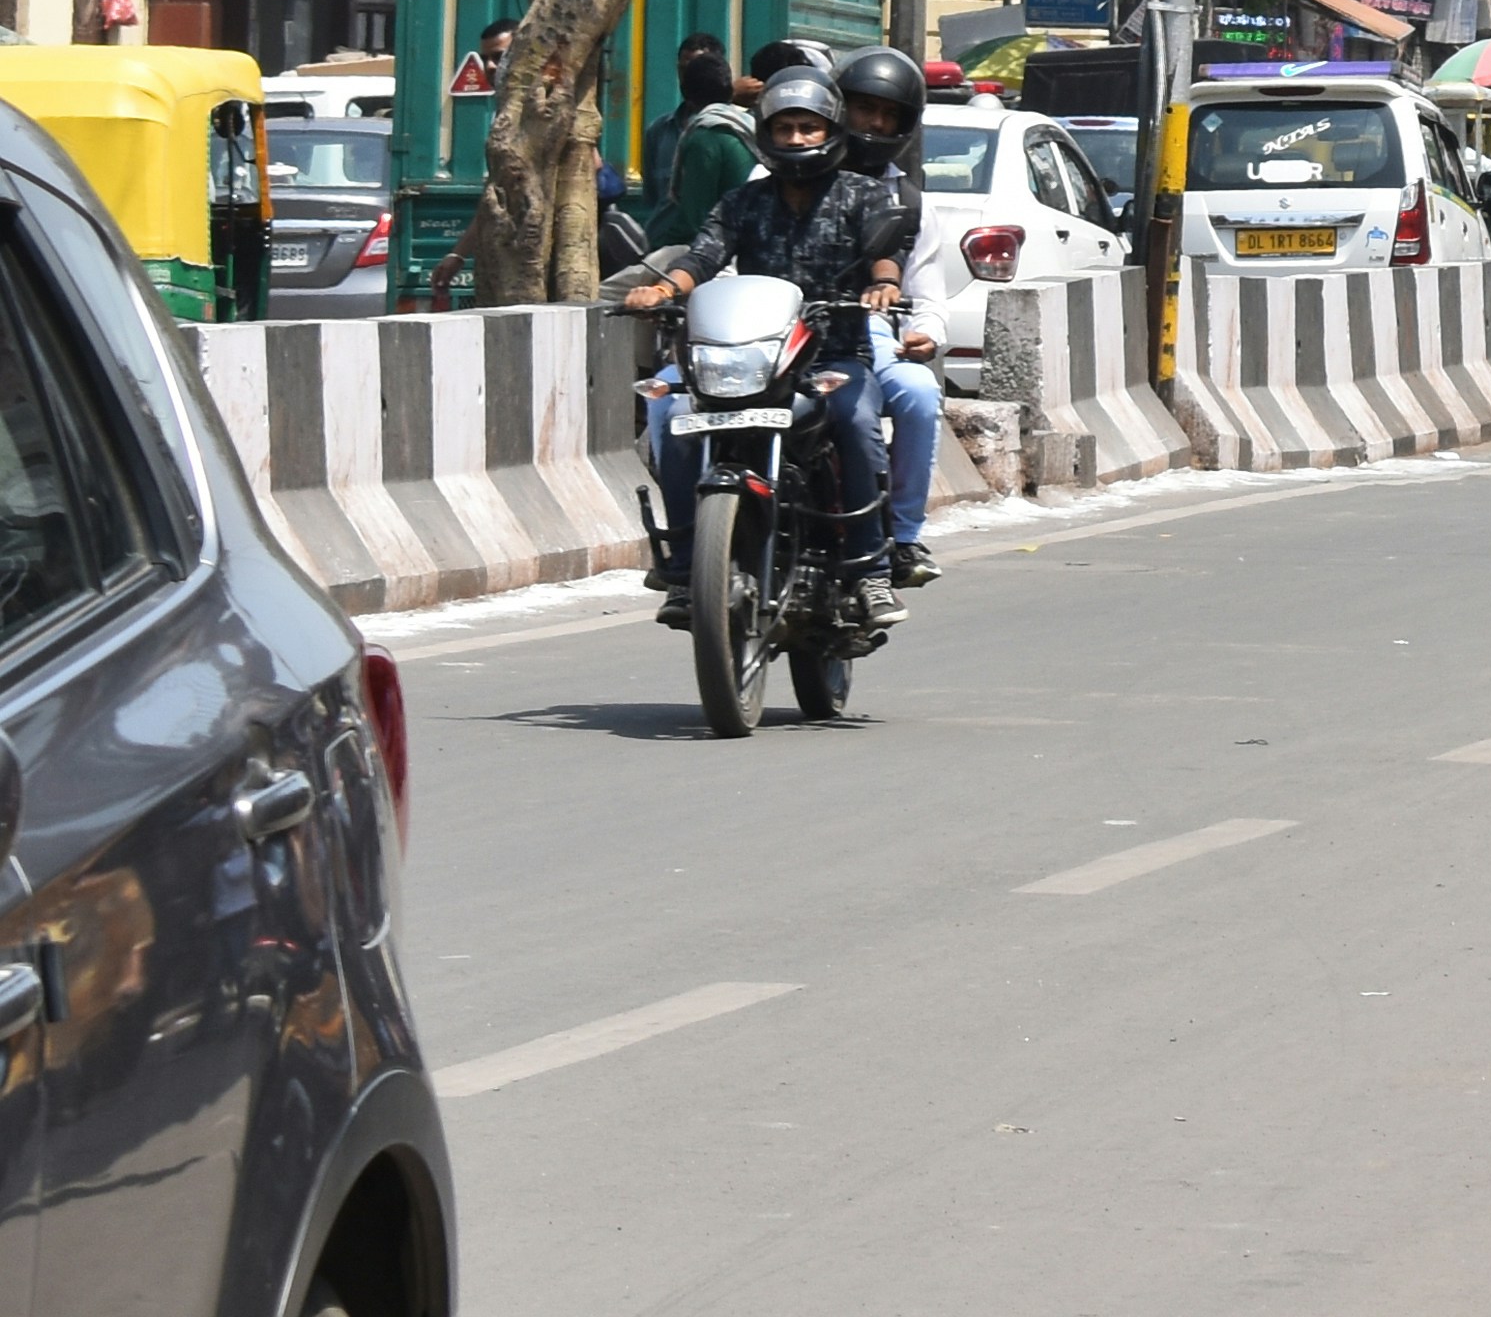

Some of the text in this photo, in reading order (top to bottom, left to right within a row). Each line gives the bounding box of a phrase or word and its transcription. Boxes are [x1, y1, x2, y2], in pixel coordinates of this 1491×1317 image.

[1246, 161, 1324, 182] UR
[1247, 234, 1264, 250] DL
[1269, 234, 1293, 250] 1RT
